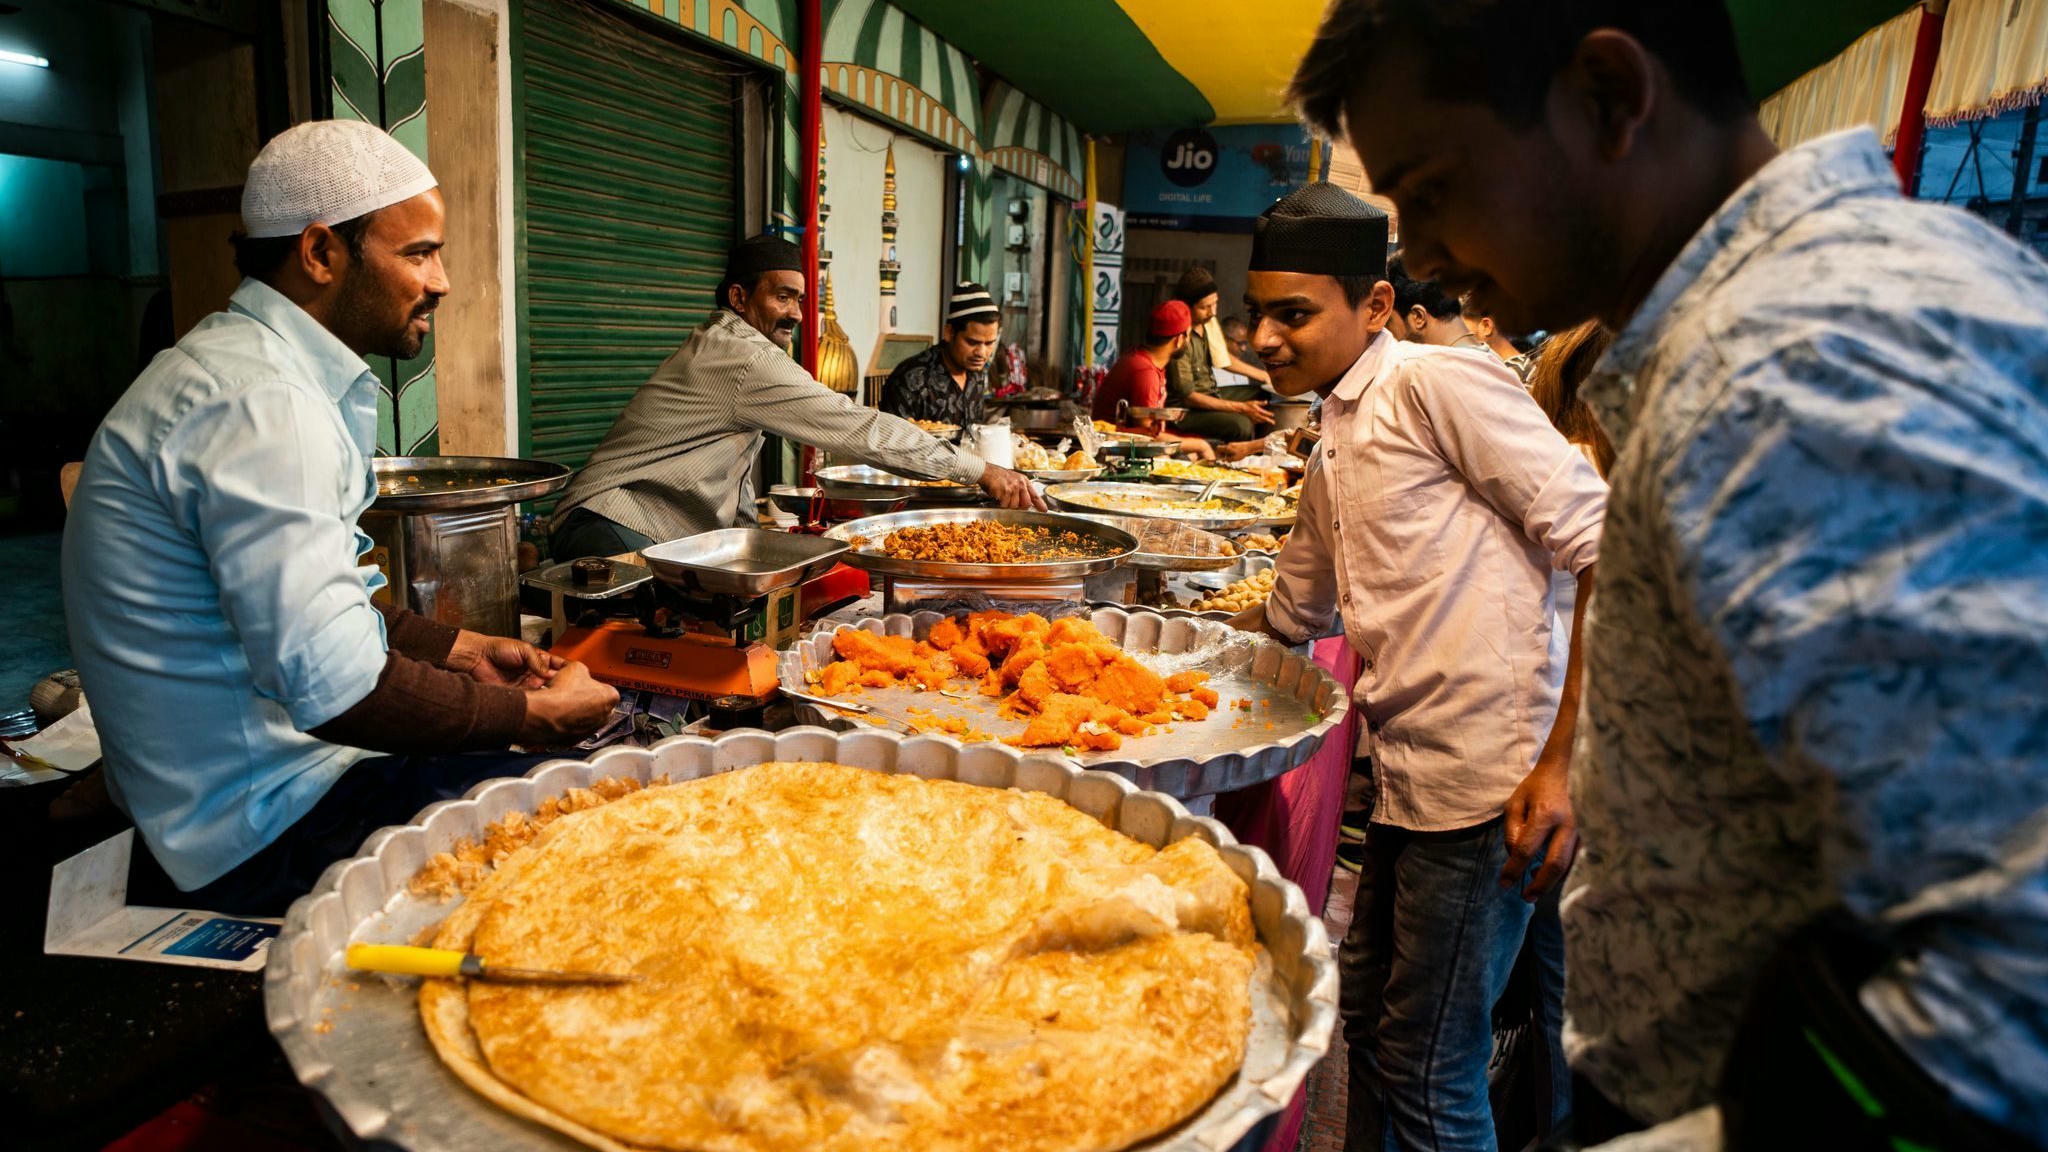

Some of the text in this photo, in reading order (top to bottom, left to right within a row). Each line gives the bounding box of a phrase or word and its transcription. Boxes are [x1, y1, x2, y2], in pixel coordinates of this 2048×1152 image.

[1167, 142, 1213, 170] Jio
[1159, 192, 1213, 203] DIGITAL LIFE
[634, 682, 672, 694] SURYA
